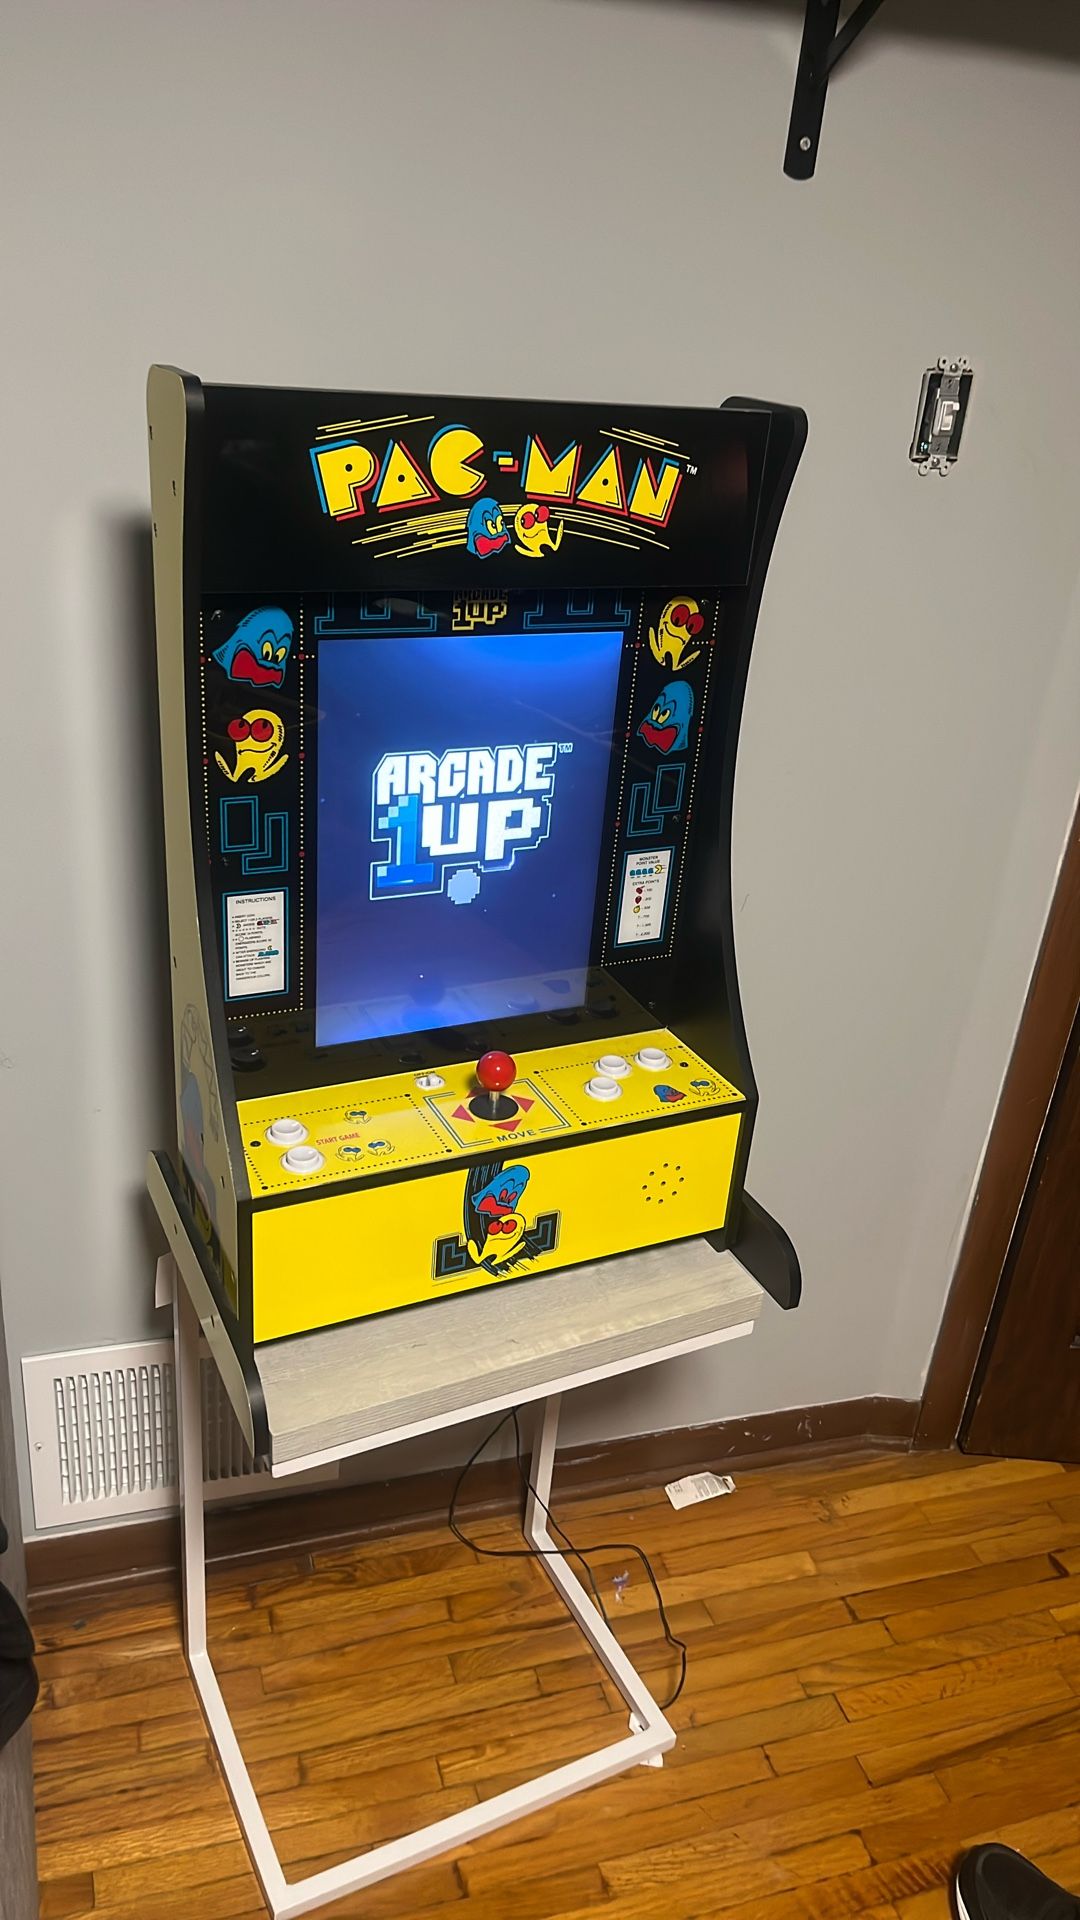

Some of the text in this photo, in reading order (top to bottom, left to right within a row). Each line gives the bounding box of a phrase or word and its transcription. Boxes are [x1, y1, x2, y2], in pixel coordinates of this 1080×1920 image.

[309, 424, 682, 527] PAC-MAN
[376, 745, 554, 805] ARCADE
[376, 795, 542, 888] 1UP
[235, 896, 276, 904] INSTRUCTIONS
[315, 1132, 361, 1146] START GAME
[496, 1129, 537, 1142] MOVE
